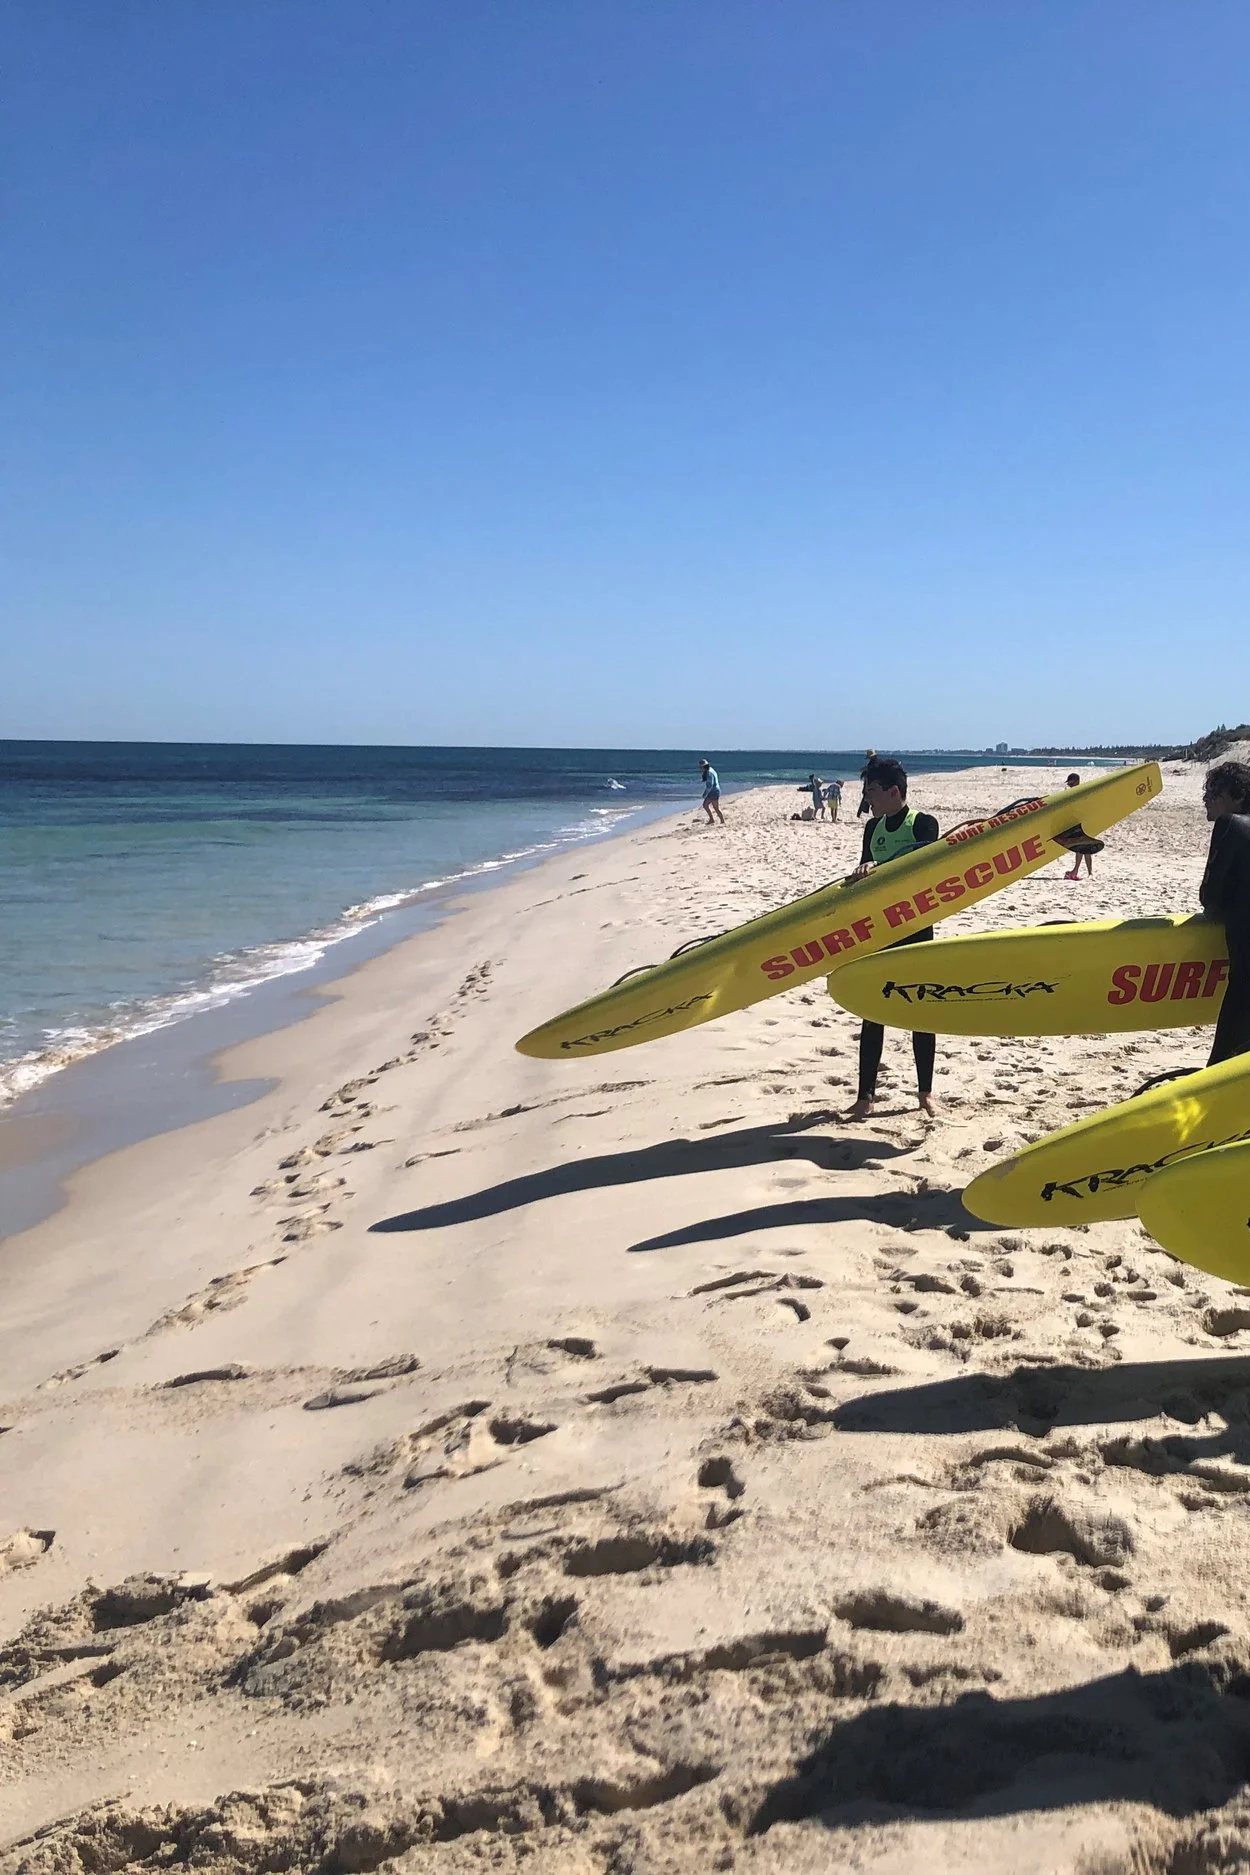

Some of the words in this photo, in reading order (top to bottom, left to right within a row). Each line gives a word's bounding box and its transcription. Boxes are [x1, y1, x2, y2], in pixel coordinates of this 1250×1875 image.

[945, 823, 985, 846] SURF
[988, 799, 1048, 829] RESCUE
[761, 917, 876, 980] SURF
[883, 834, 1046, 928] RESCUE
[882, 981, 1060, 1004] KRACKA
[1107, 959, 1229, 1005] SURF
